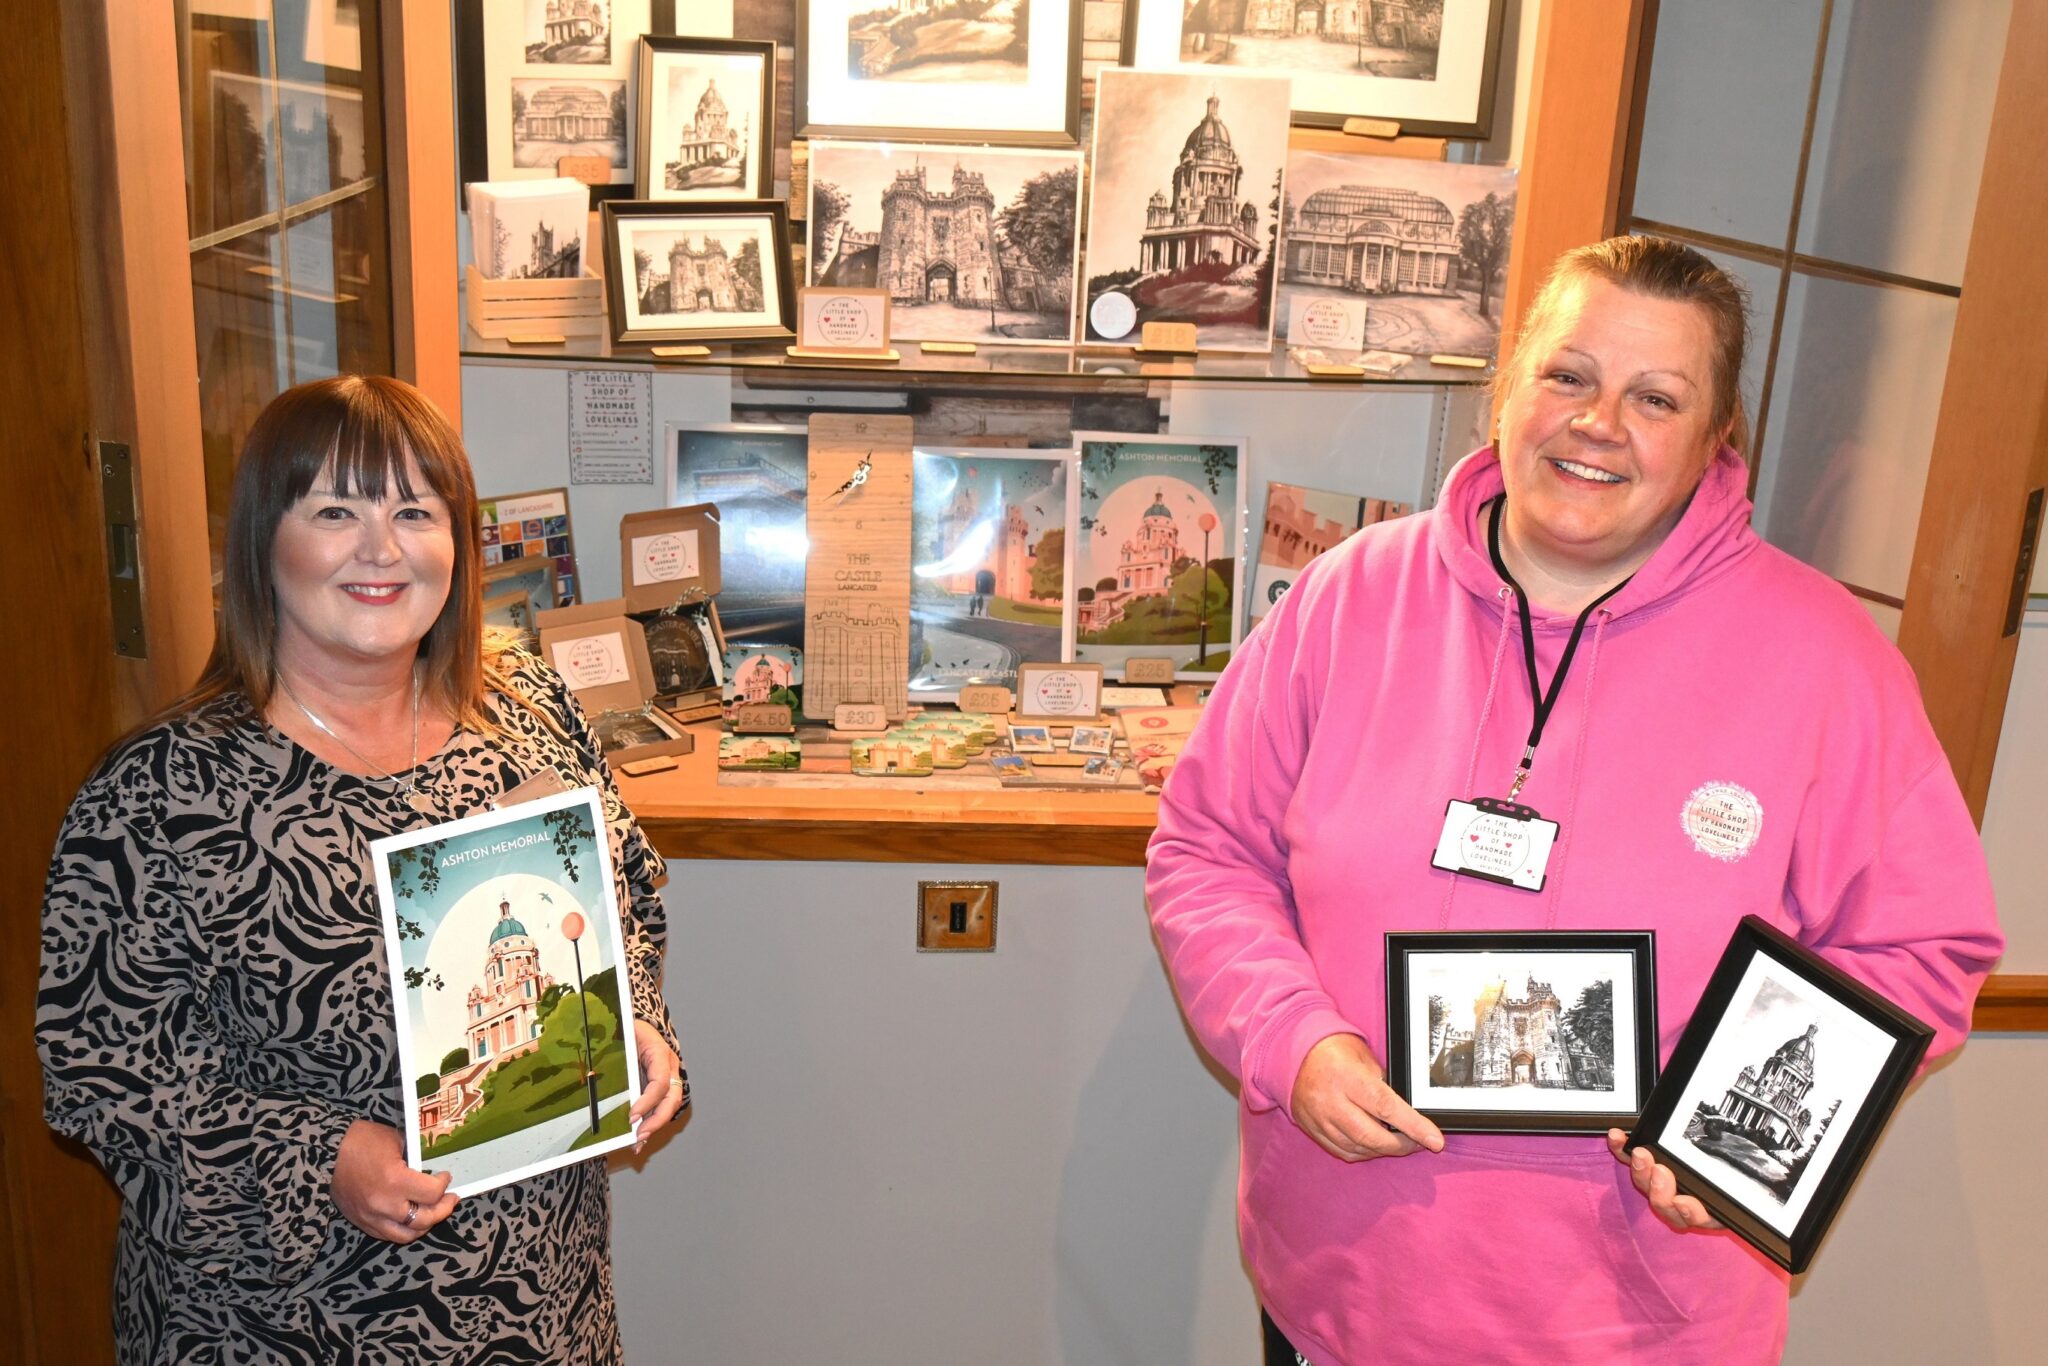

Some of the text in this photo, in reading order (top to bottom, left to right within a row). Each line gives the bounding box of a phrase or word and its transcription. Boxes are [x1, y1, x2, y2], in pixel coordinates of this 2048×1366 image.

[605, 375, 633, 383] LITTLE
[592, 388, 629, 396] SHOP OF
[587, 402, 635, 410] HANDMADE
[585, 416, 639, 424] LOVELINESS
[1119, 453, 1201, 463] ASHTON MEMORIAL
[847, 553, 871, 565] THE
[834, 571, 882, 582] CASTLE
[837, 583, 878, 591] LANCASTER
[991, 670, 1018, 678] CASTL
[969, 692, 1000, 707] £25
[741, 712, 788, 726] £4.50
[845, 710, 875, 724] £30
[1719, 801, 1733, 810] THE
[1701, 806, 1748, 825] LITTLE SHOP
[1495, 819, 1508, 828] THE
[1710, 820, 1745, 835] HANDMADE
[1475, 825, 1523, 840] LITTLE SHOP
[1701, 826, 1739, 843] LOVELINESS
[441, 831, 551, 868] ASHTON MEMORIAL
[1475, 843, 1513, 858] HANDMADE
[1470, 853, 1512, 867] LOVELINESS
